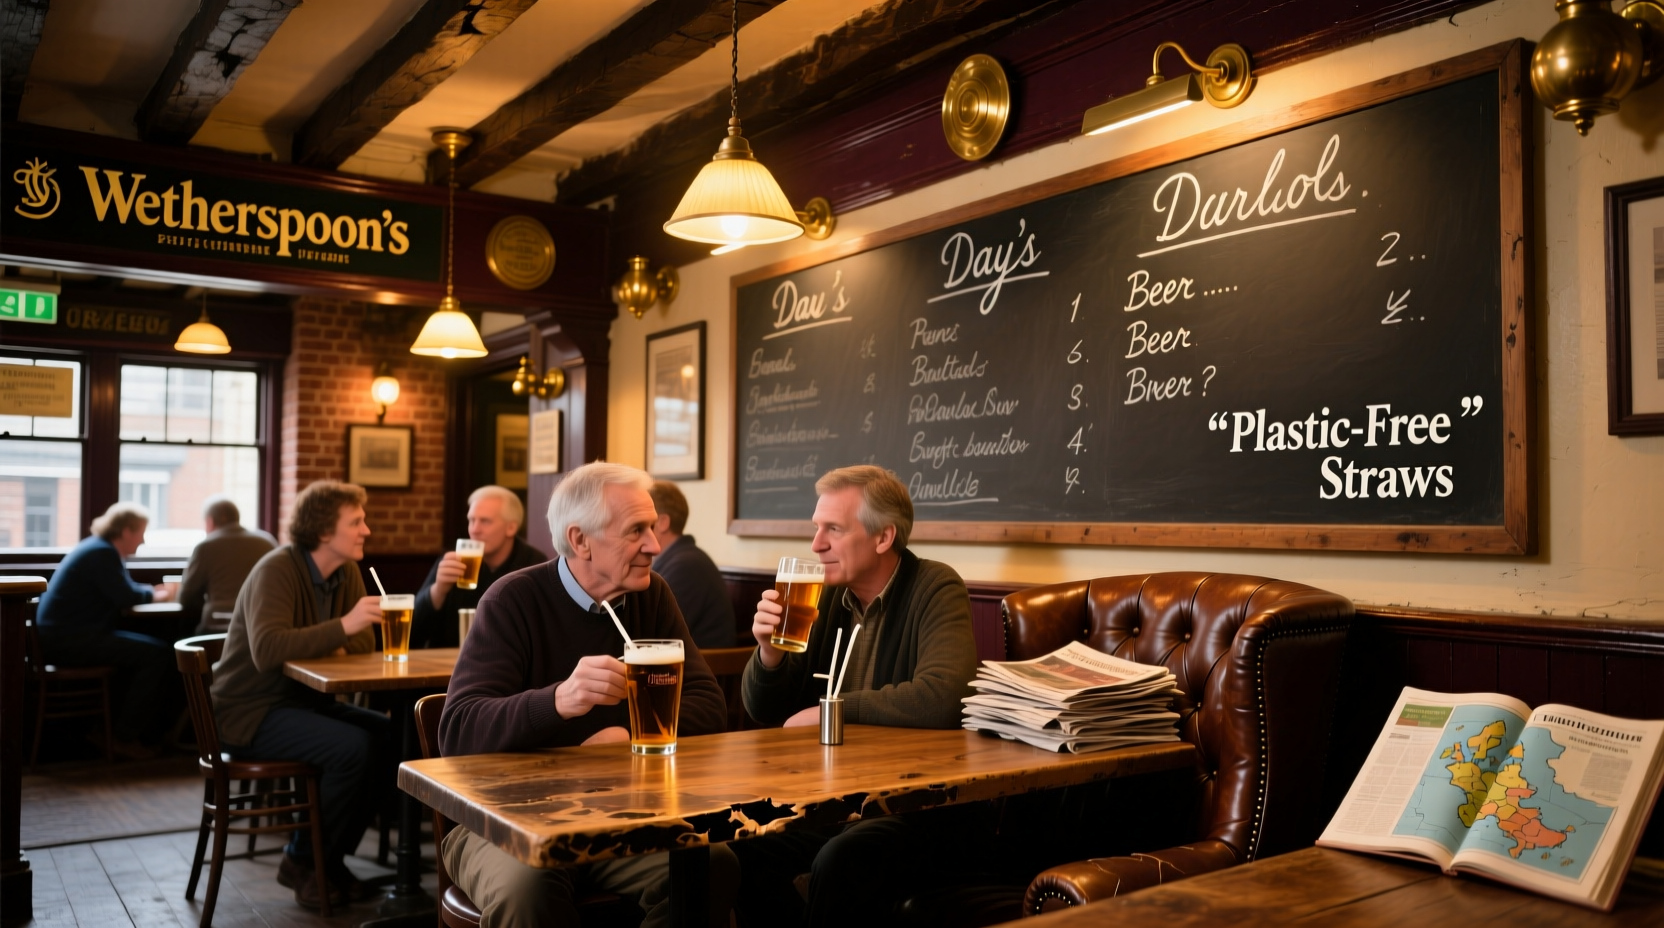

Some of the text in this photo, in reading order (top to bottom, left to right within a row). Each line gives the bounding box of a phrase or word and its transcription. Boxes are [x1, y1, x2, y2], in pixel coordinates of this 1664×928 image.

[78, 165, 410, 257] Wetherspoon's
[941, 218, 1042, 315] Day's
[1319, 455, 1454, 500] Straws
